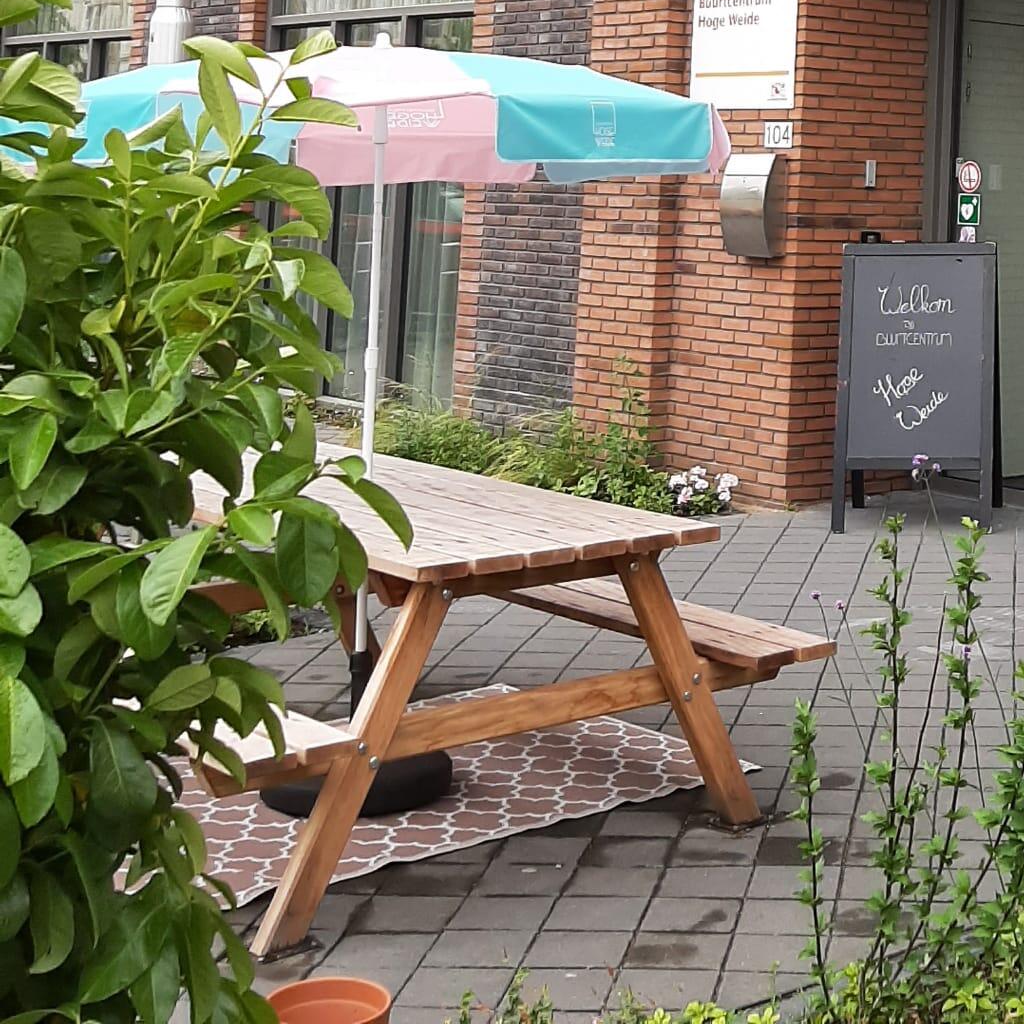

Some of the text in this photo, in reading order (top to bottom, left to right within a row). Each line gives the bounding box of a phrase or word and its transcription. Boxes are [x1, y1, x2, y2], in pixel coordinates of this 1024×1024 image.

[698, 12, 760, 31] Hoge Weide
[767, 126, 790, 144] 104
[878, 284, 956, 314] Welkom
[873, 368, 924, 406] Hoge
[895, 391, 949, 430] Weide
